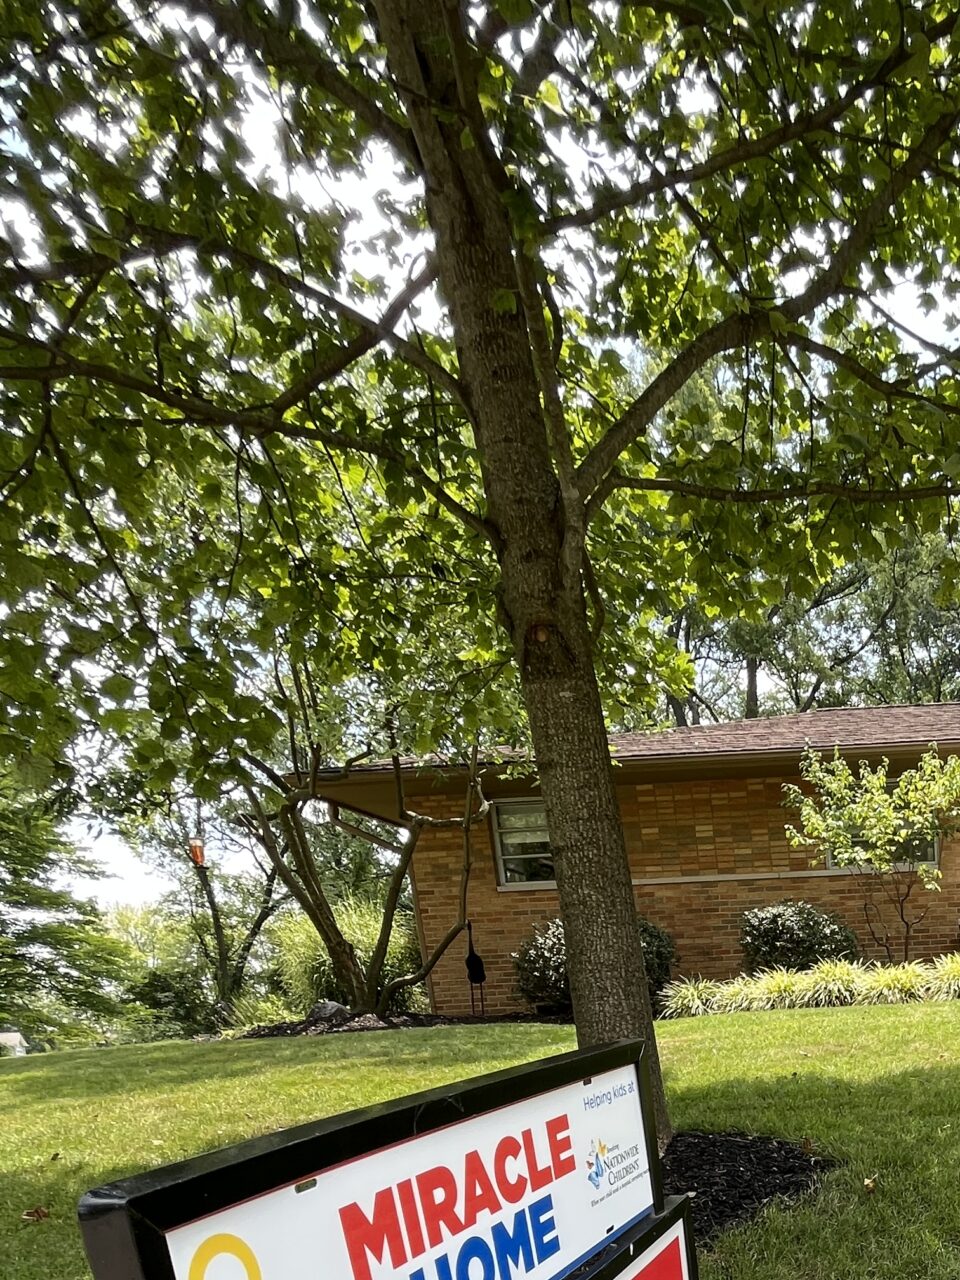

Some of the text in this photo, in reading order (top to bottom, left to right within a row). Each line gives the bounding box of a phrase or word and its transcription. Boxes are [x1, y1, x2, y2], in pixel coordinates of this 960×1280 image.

[583, 1080, 636, 1111] Helping kids at
[603, 1144, 639, 1173] NATIONWIDE
